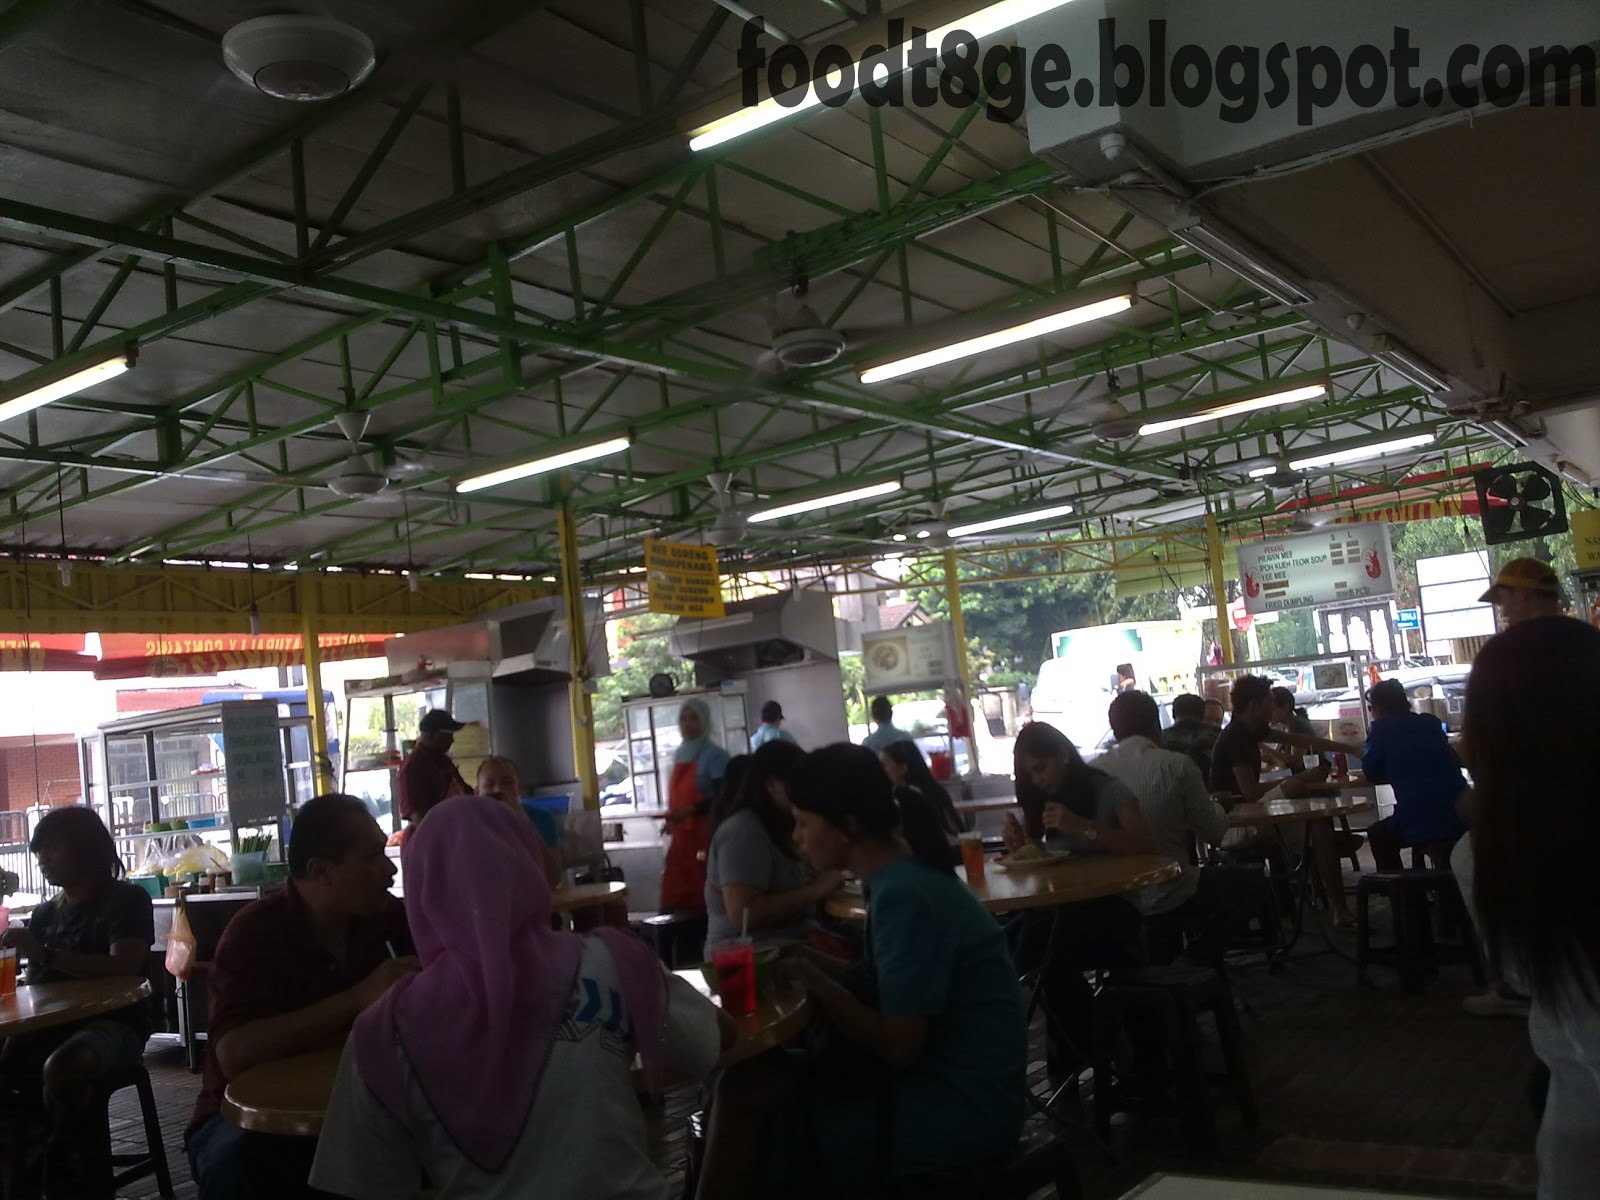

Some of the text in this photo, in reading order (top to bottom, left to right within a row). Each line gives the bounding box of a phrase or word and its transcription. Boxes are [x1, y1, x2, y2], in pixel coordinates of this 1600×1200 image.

[1258, 550, 1293, 563] PRAWN MEE
[1310, 554, 1328, 564] SOUP
[1261, 570, 1286, 582] YEE MEE
[1265, 595, 1314, 609] FRIED DUMPLING
